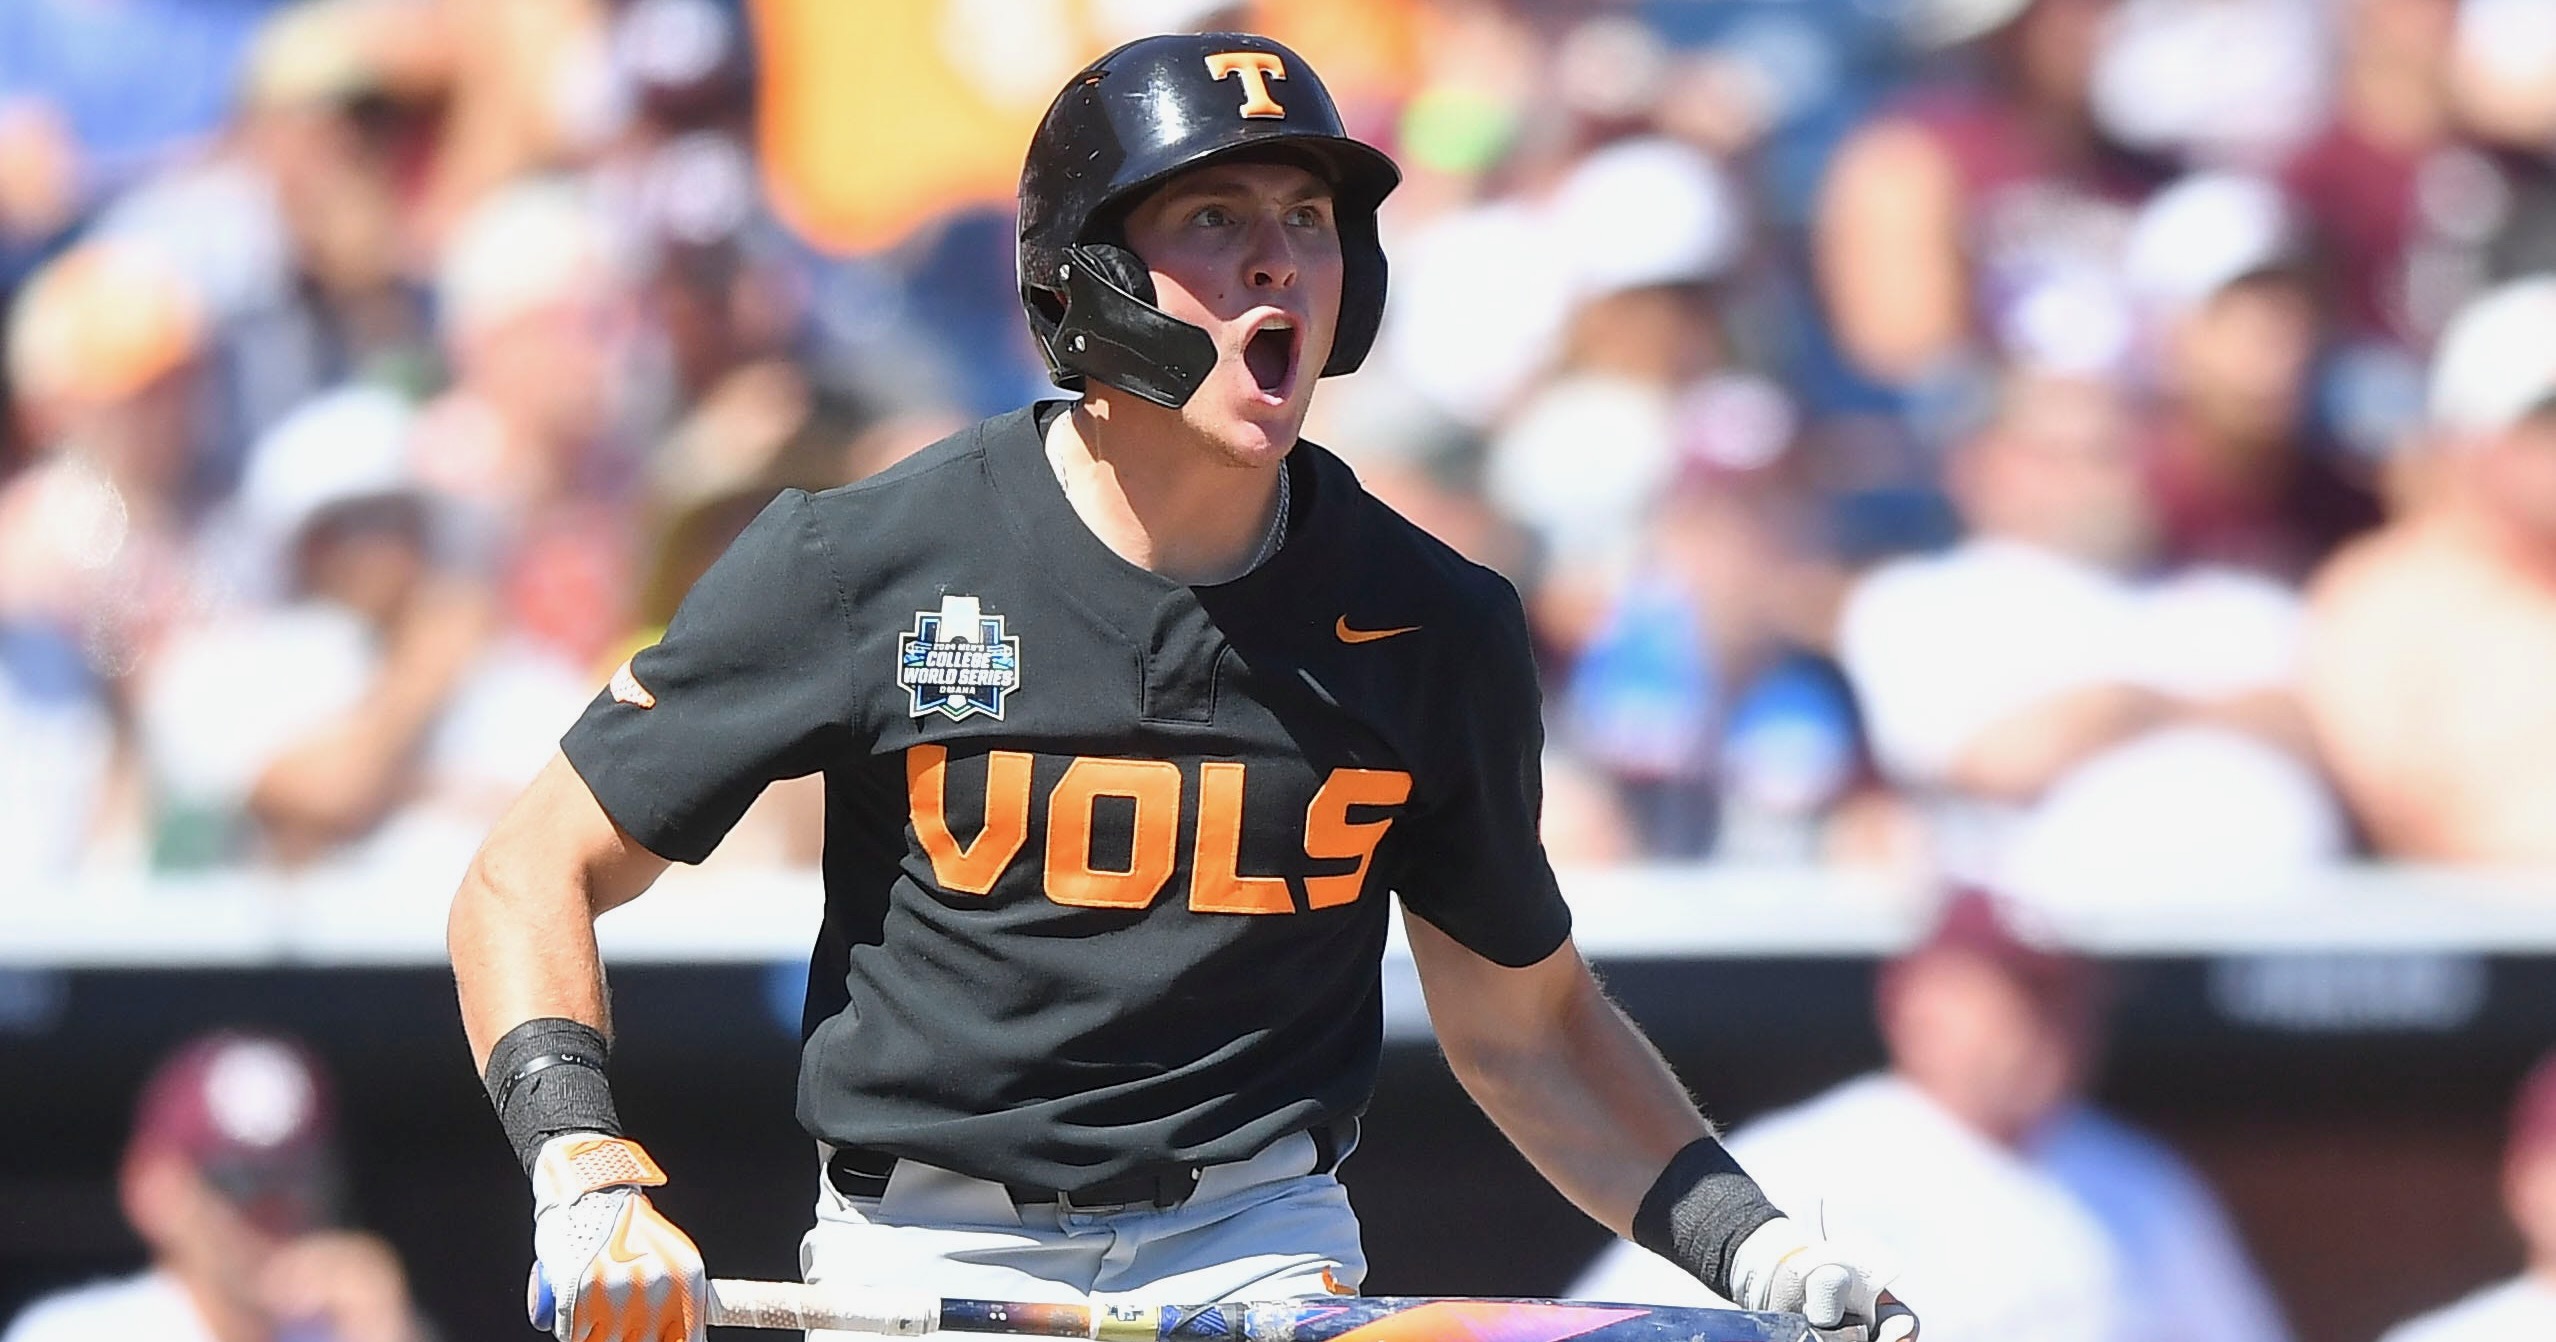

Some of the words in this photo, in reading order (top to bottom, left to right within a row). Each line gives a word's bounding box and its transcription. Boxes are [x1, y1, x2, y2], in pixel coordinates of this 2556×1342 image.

[1204, 51, 1287, 119] T
[925, 651, 992, 669] COLLEGE
[903, 667, 958, 685] WORLD
[957, 668, 1014, 687] SERIES
[939, 686, 976, 694] OMAHA
[906, 743, 1413, 914] VOLS
